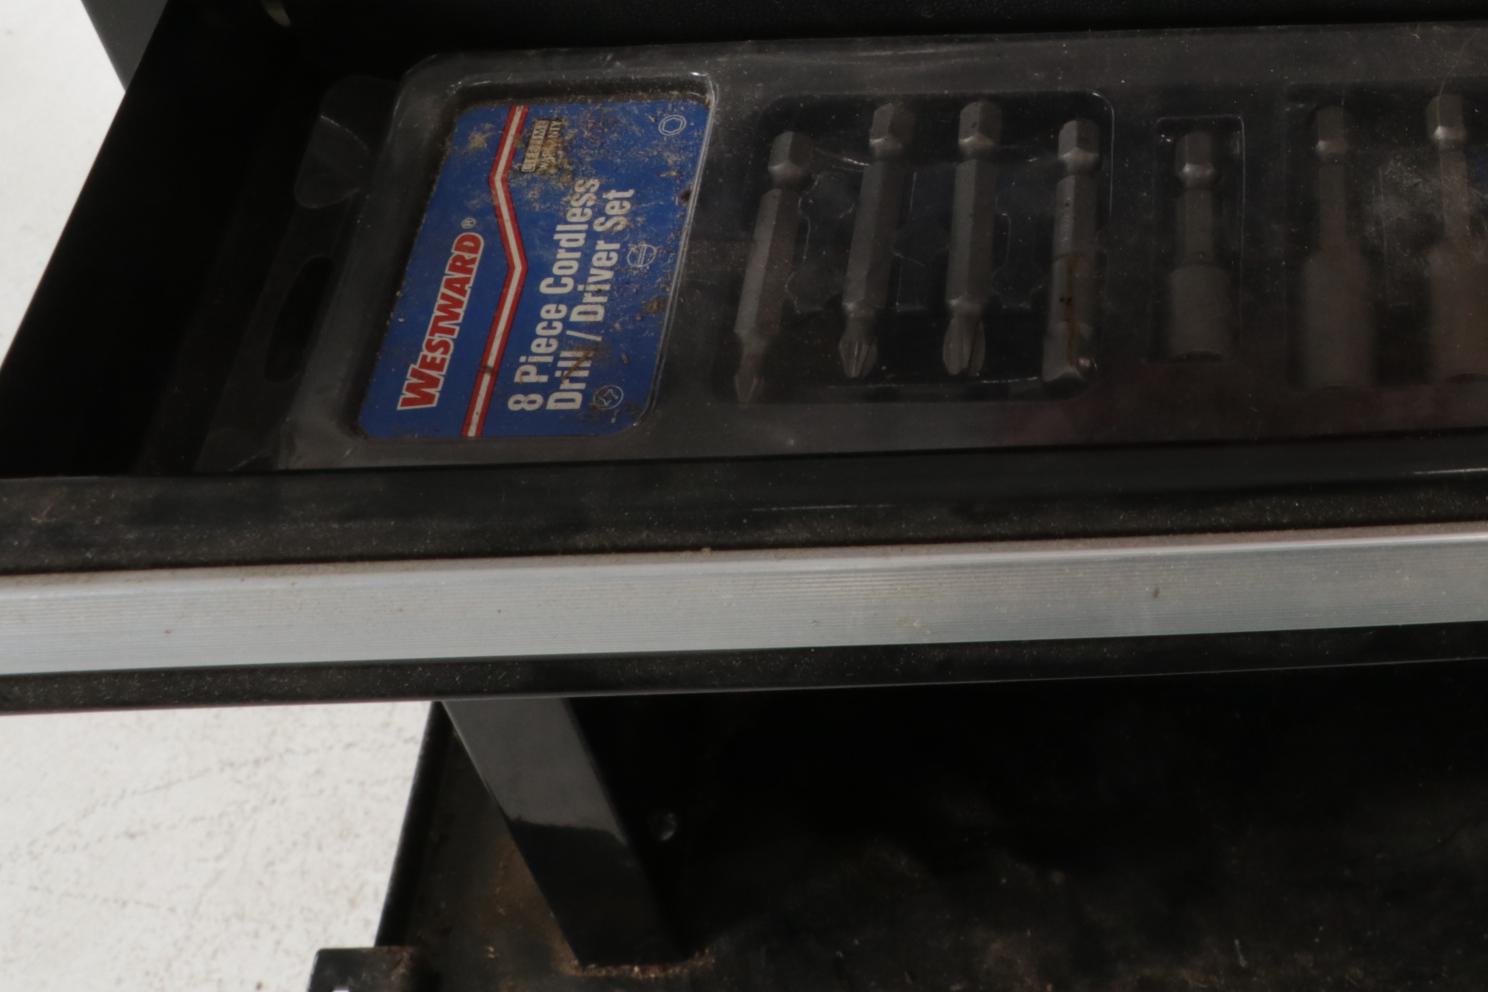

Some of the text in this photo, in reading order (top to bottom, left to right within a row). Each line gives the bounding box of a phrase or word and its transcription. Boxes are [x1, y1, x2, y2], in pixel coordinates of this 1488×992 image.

[593, 188, 635, 233] Set
[397, 232, 484, 410] WESTWARD
[507, 177, 600, 411] 8 Piece Cordless
[570, 241, 619, 323] Driver
[546, 343, 594, 410] Drill
